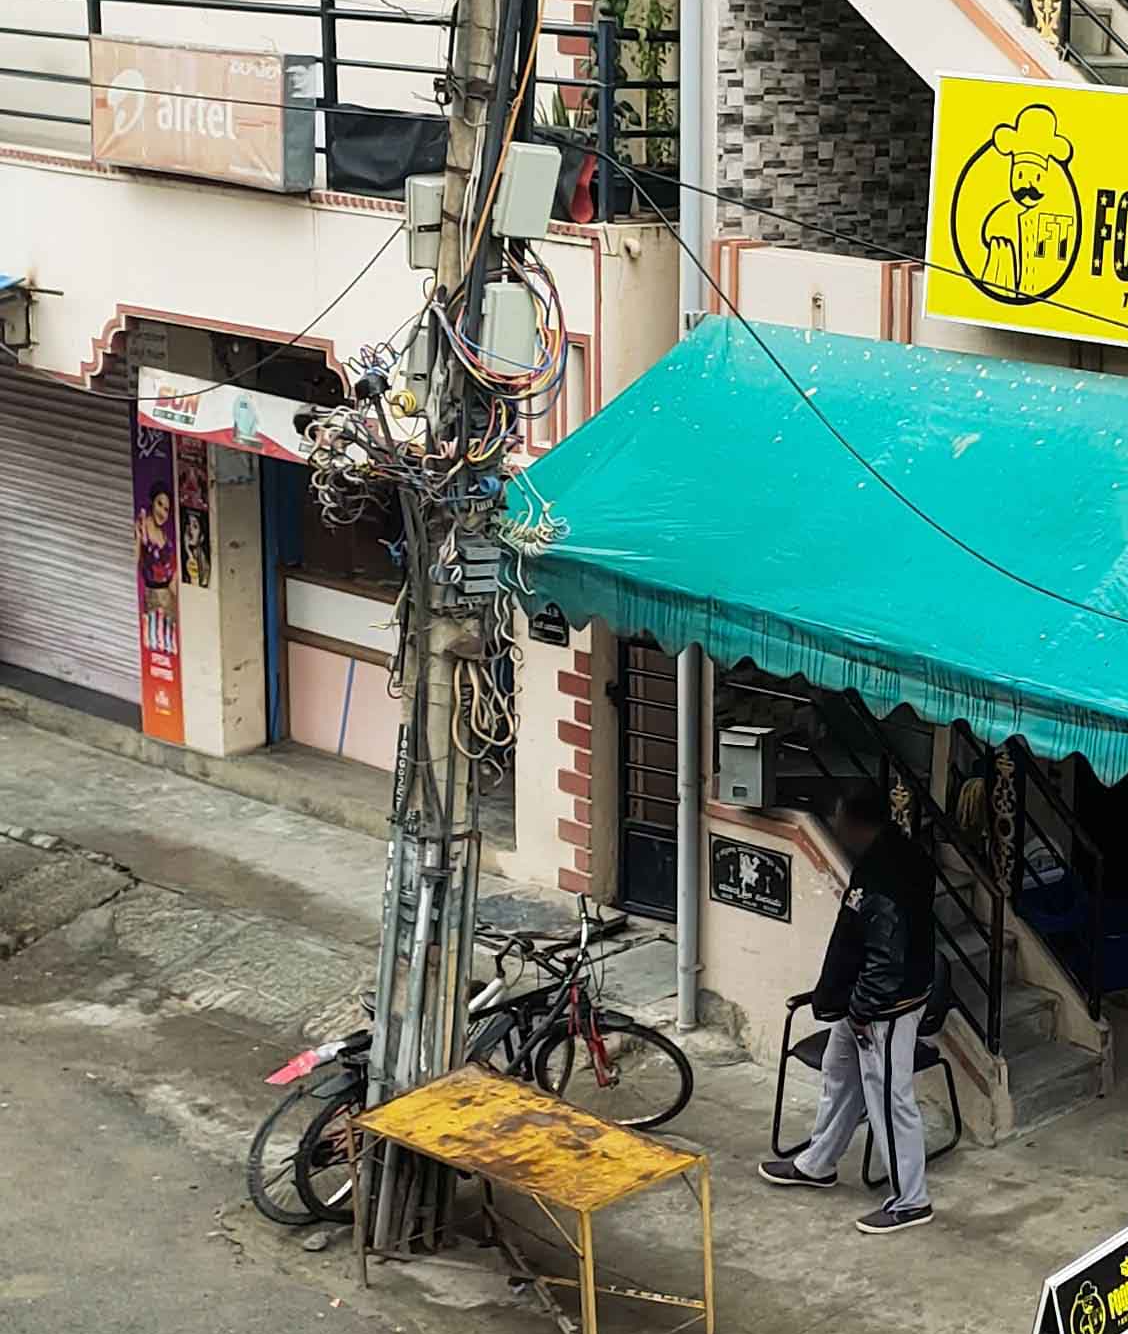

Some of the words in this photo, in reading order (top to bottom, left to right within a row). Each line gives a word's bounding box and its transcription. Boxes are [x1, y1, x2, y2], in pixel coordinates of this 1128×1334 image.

[156, 85, 237, 140] airtel
[1034, 212, 1075, 261] FT
[155, 386, 200, 416] SUN
